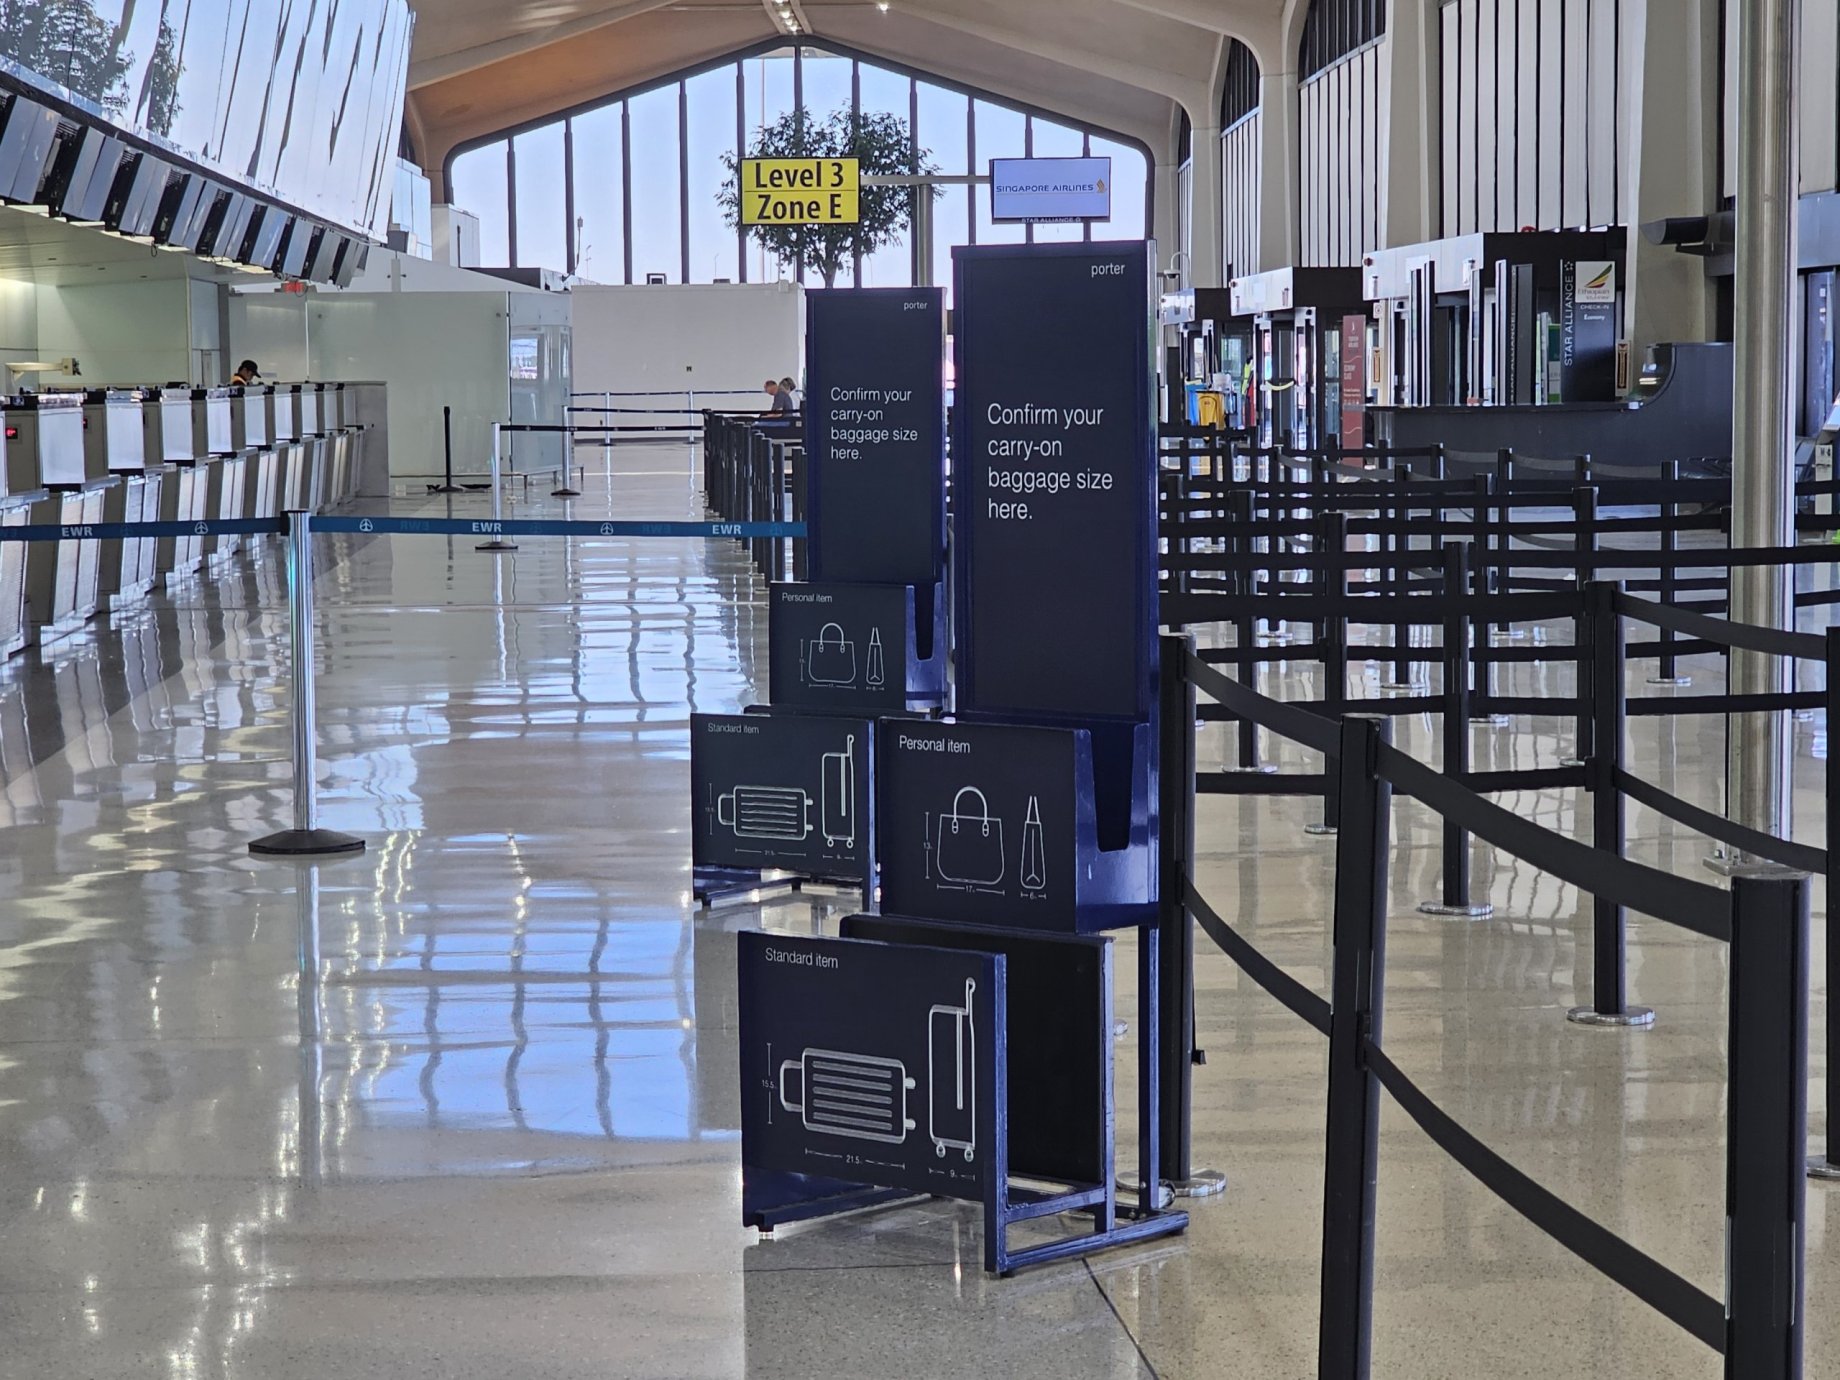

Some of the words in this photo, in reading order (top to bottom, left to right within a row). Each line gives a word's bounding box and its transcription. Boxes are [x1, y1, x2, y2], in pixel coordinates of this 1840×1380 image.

[755, 161, 822, 188] Level
[830, 162, 844, 187] 3
[996, 184, 1049, 193] SINGAPORE
[1052, 183, 1094, 192] AIRLINES
[757, 194, 821, 220] Zone
[829, 193, 842, 219] E
[1091, 262, 1125, 278] porter
[903, 301, 928, 311] porter
[1564, 275, 1574, 334] ALLIANCE
[1564, 336, 1573, 366] STAR
[830, 386, 880, 401] Confirm
[884, 390, 912, 405] your
[830, 409, 883, 424] carry-on
[987, 402, 1058, 425] Confirm
[1063, 408, 1104, 430] your
[830, 426, 889, 444] baggage
[892, 427, 918, 441] size
[830, 445, 862, 460] here.
[987, 439, 1062, 461] carry-on
[988, 466, 1071, 494] baggage
[1076, 467, 1113, 490] size
[988, 497, 1033, 520] here.
[61, 526, 93, 537] EWR
[472, 522, 502, 533] EWR
[712, 524, 742, 535] EWR
[781, 592, 815, 603] Personal
[815, 594, 833, 603] item
[707, 722, 742, 733] Standard
[743, 725, 760, 735] item
[899, 735, 945, 751] Personal
[947, 739, 971, 754] item
[765, 947, 813, 966] Standard
[815, 954, 839, 969] item
